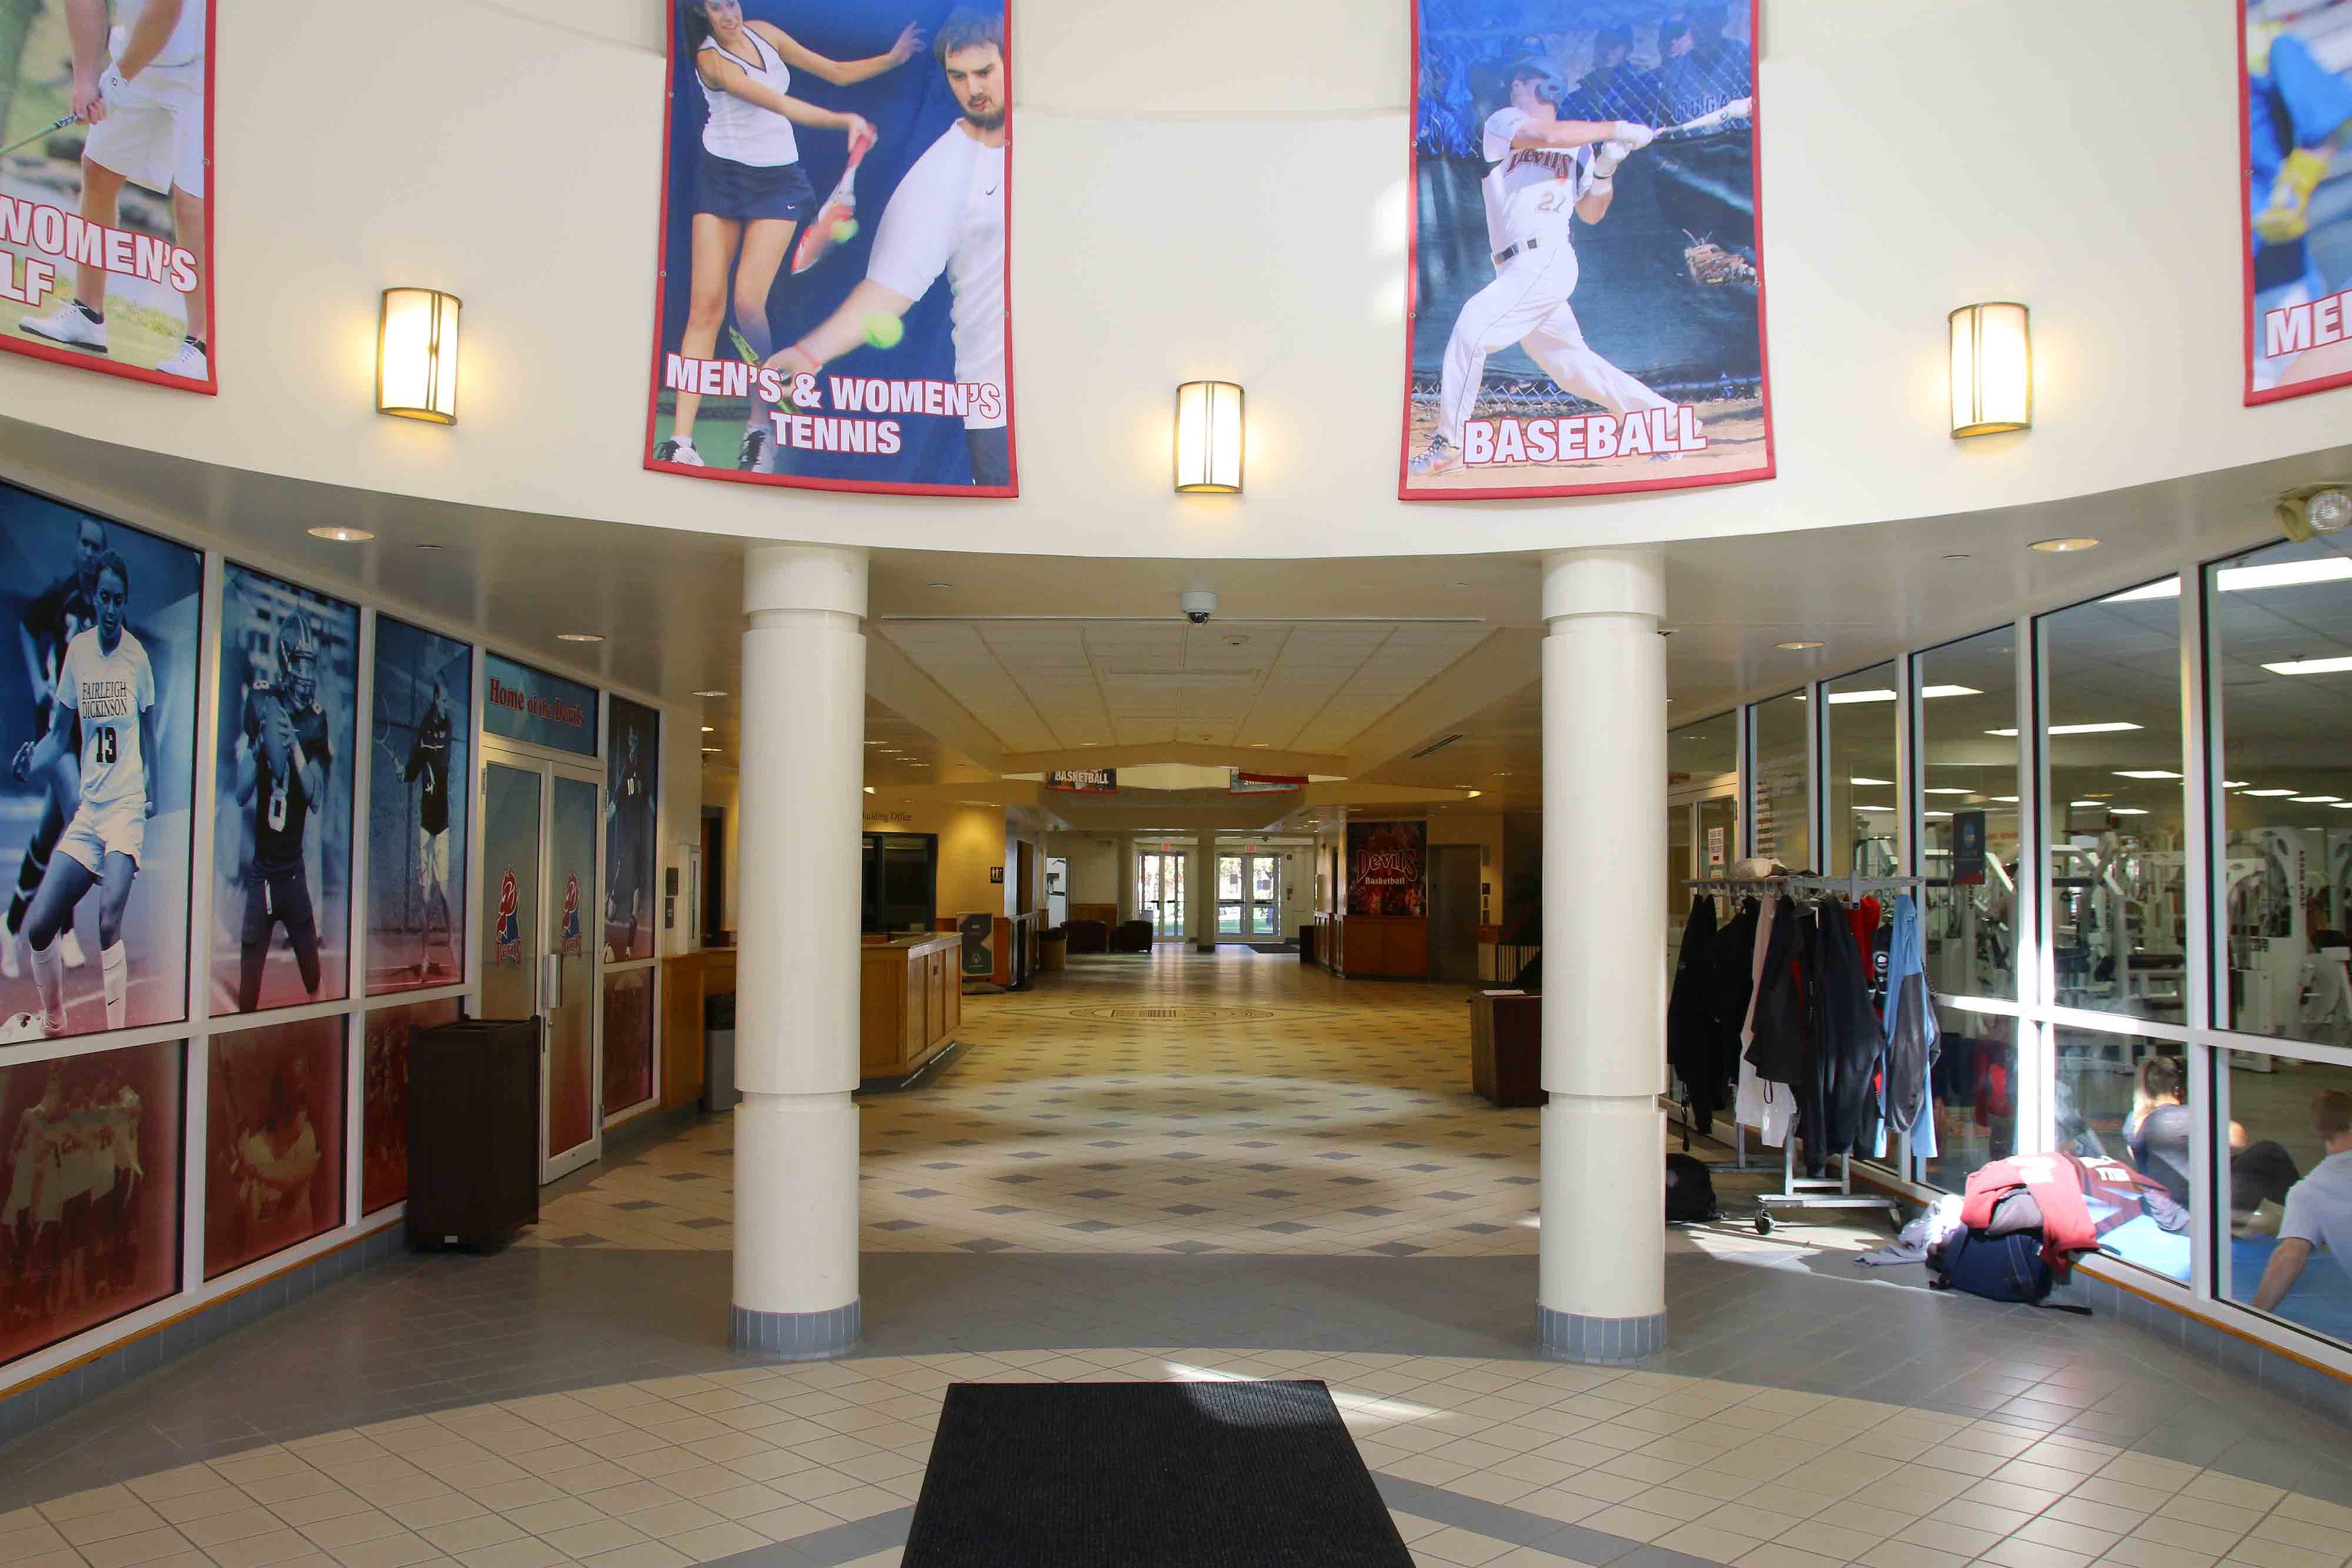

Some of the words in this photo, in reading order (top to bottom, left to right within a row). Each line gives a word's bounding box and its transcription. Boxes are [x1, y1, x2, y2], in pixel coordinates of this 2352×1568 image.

[665, 353, 782, 402] MEN'S
[792, 372, 823, 409] &
[829, 375, 1002, 419] WOMEN'S
[770, 411, 902, 454] TENNIS
[1463, 405, 1708, 465] BASEBALL
[82, 681, 127, 700] FAIRLEIGH
[83, 698, 127, 719] DICKINSON
[489, 676, 524, 712] Home
[527, 696, 537, 715] of
[540, 698, 551, 719] the
[554, 696, 584, 728] Devils
[96, 726, 117, 764] 13
[627, 777, 635, 796] 10
[1055, 771, 1109, 784] BASKETBALL
[863, 810, 889, 823] uilding
[891, 811, 912, 822] Office
[1365, 876, 1405, 885] Basketball
